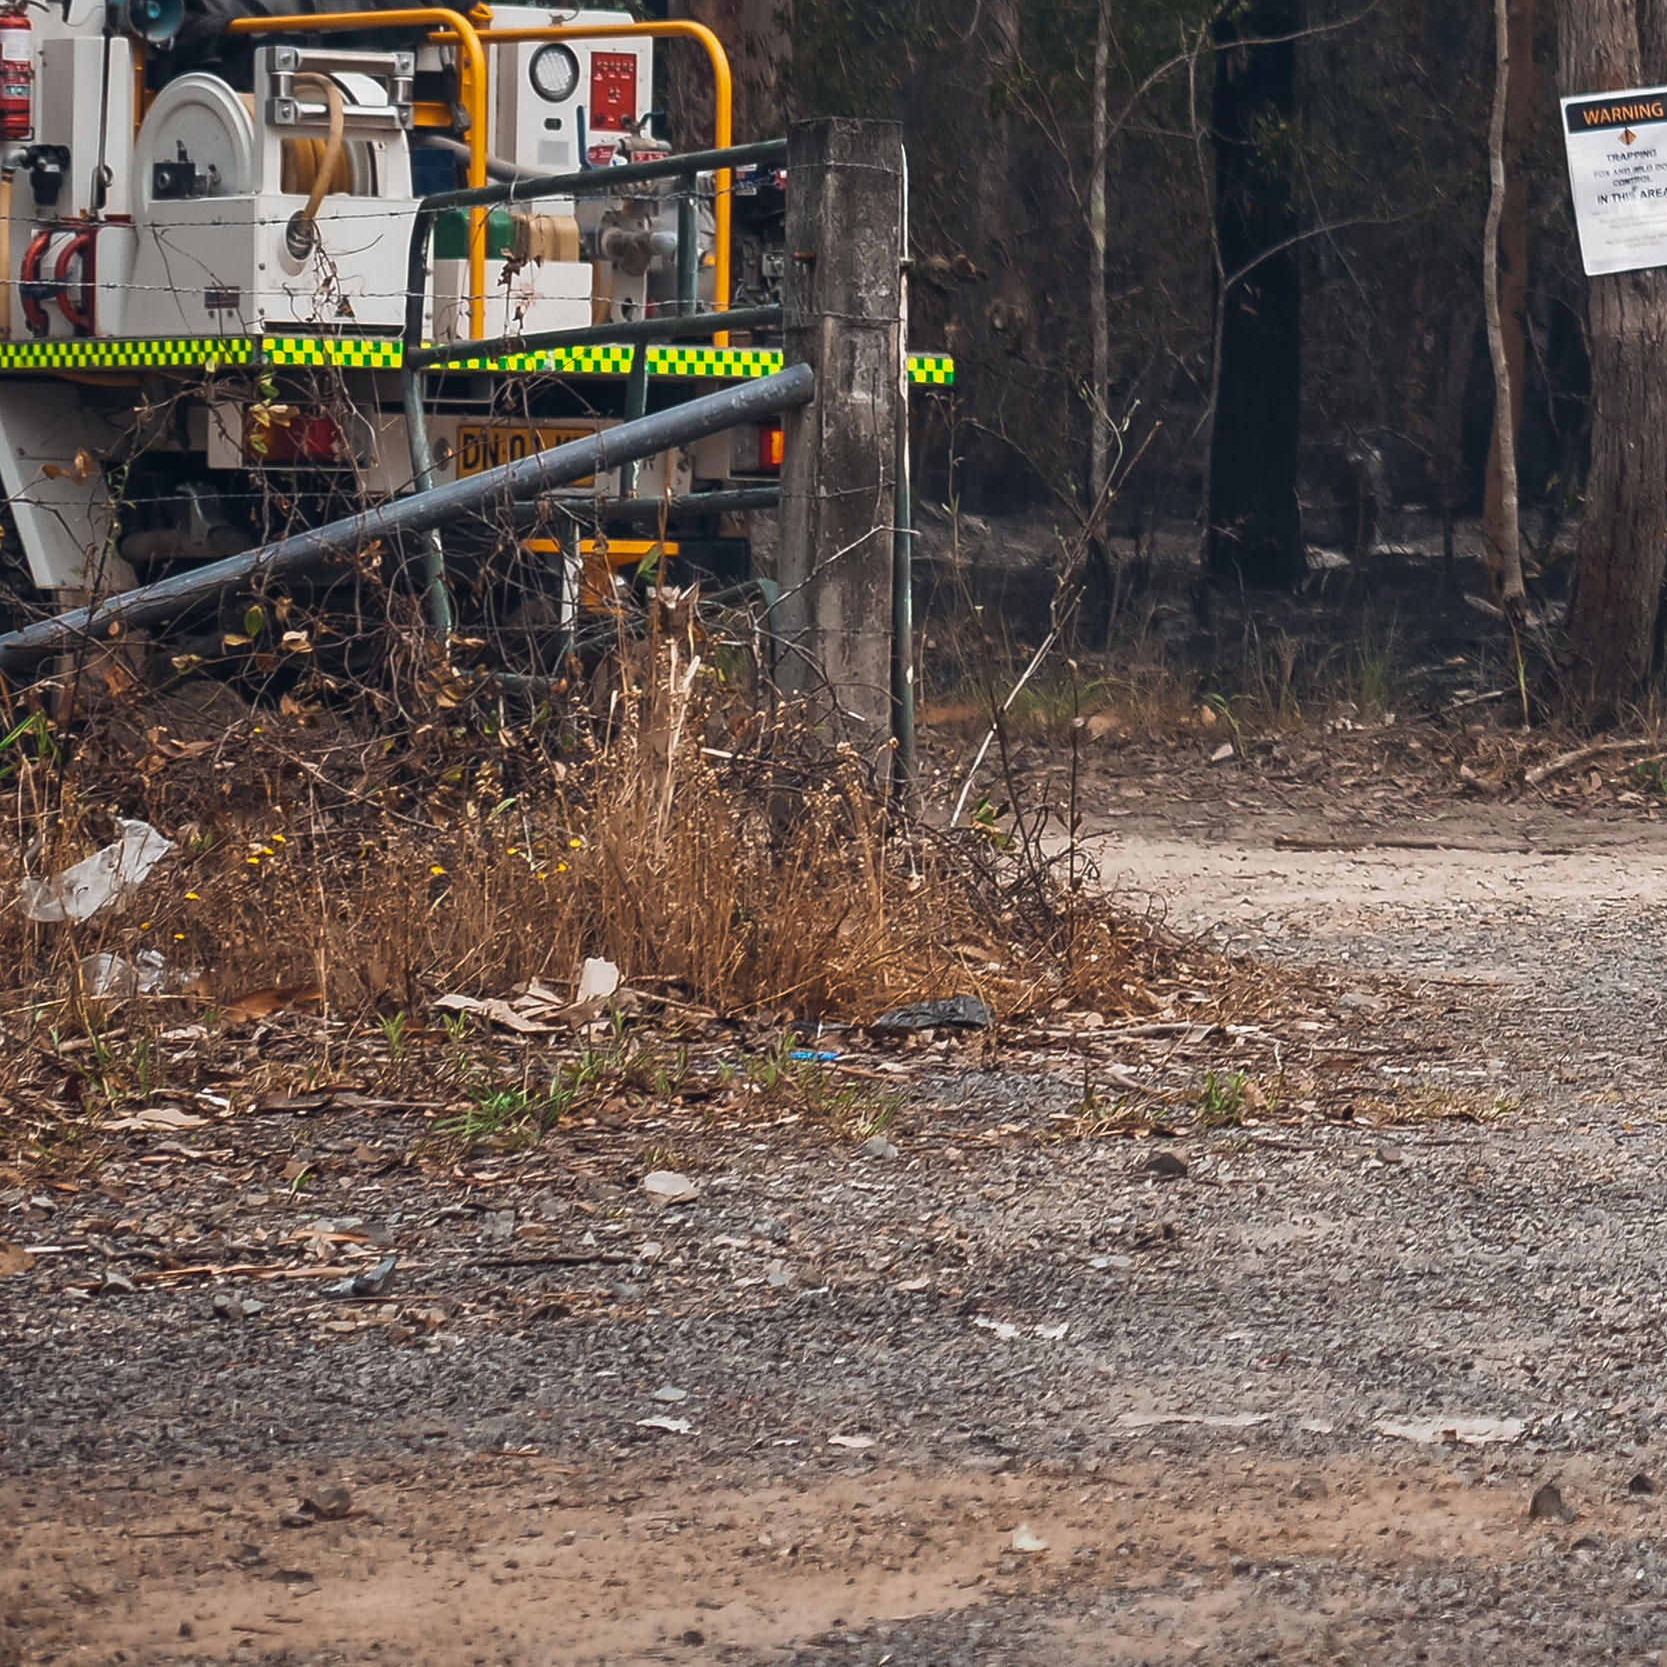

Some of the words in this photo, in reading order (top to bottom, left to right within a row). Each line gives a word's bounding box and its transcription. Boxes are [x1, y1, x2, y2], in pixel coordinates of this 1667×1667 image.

[1583, 102, 1664, 126] WARNING
[1606, 149, 1657, 162] TRAPPING
[1597, 194, 1608, 204] IN
